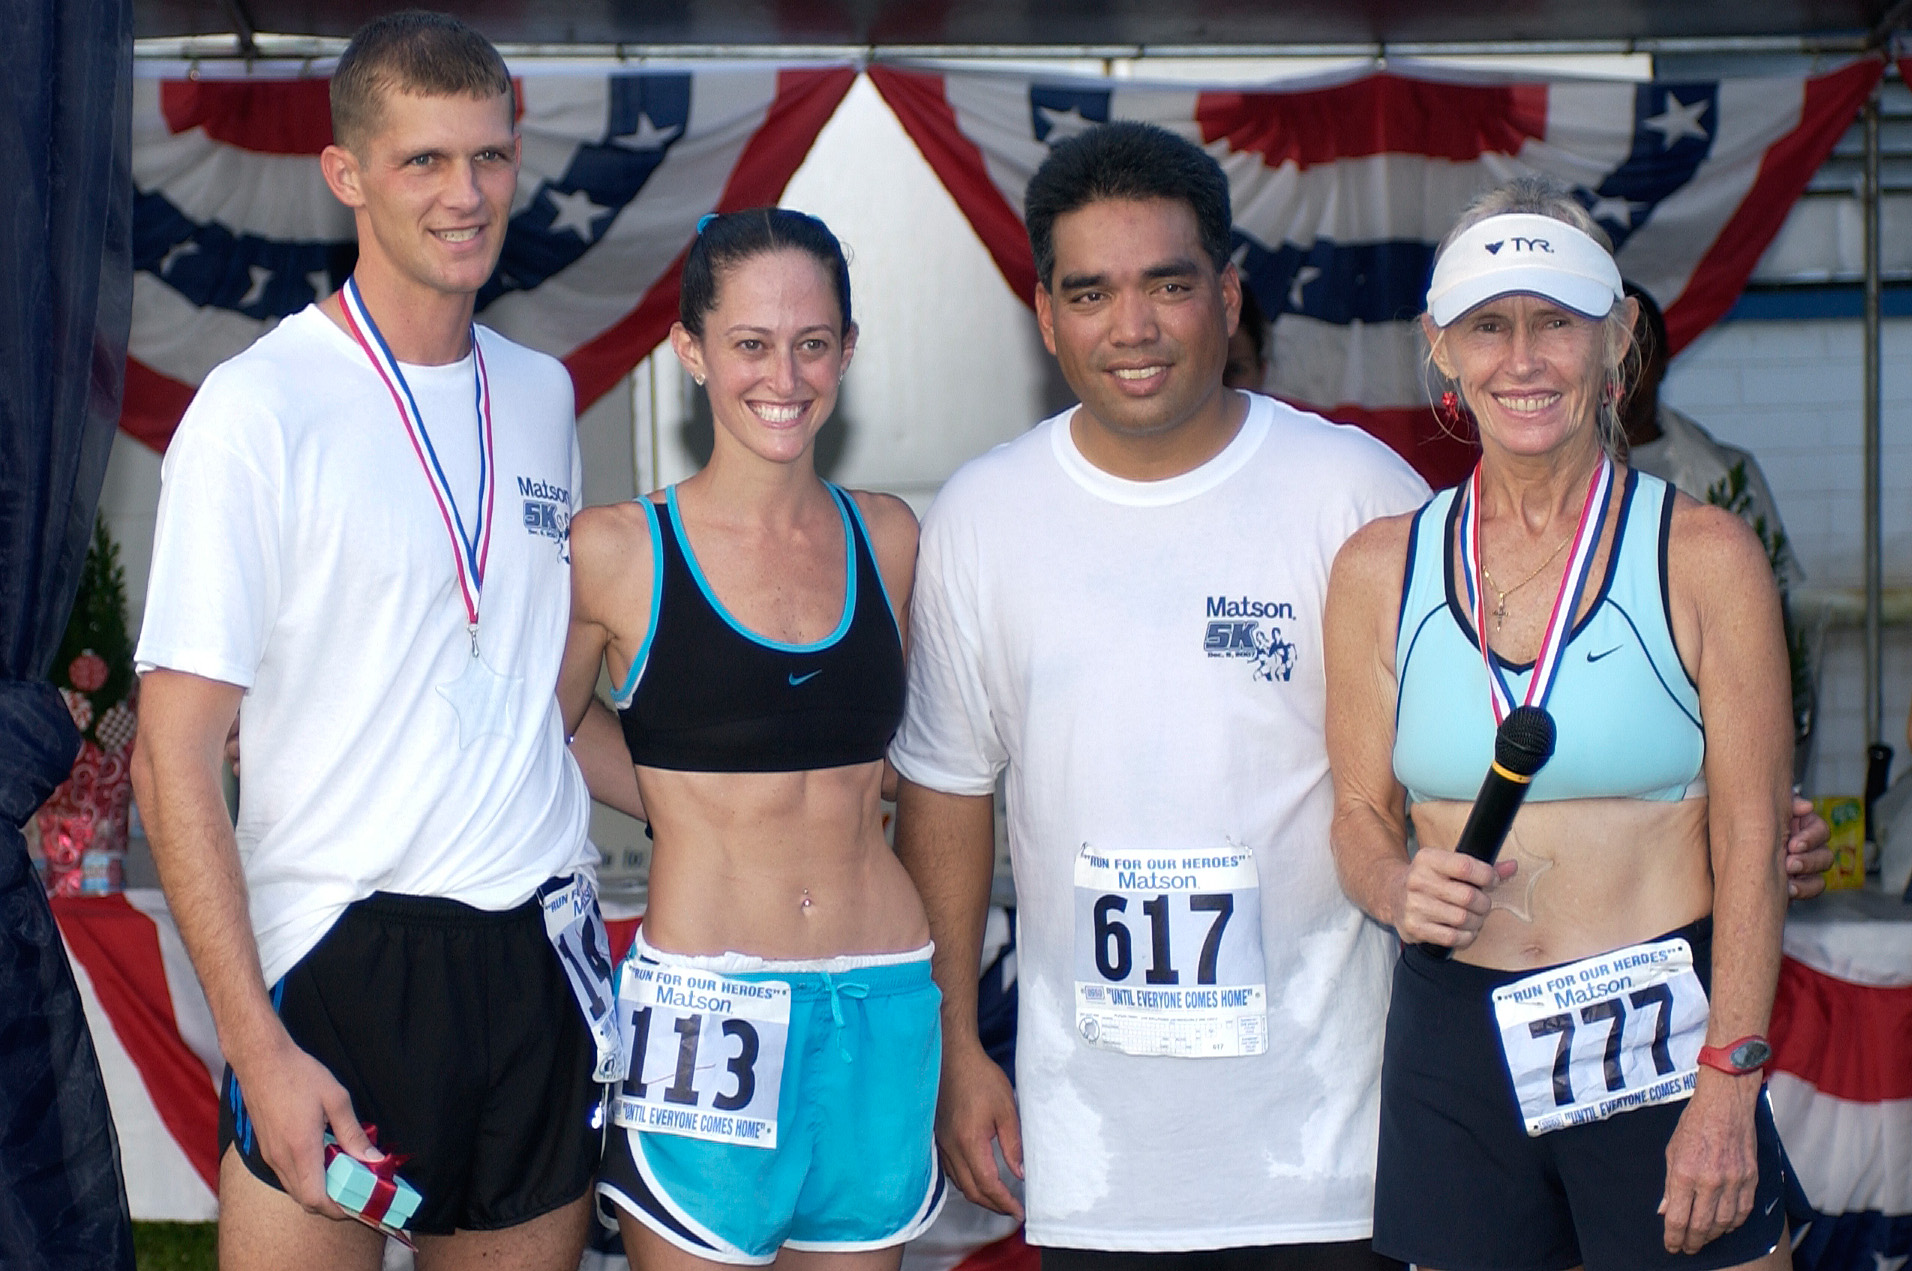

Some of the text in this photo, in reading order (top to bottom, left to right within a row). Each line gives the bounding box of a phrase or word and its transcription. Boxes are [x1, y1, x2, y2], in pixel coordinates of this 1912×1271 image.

[523, 500, 557, 530] 5K
[1204, 621, 1258, 651] 5K
[1114, 859, 1142, 870] FOR
[1147, 859, 1177, 870] OUR
[1093, 893, 1234, 986] 617
[656, 972, 682, 986] FOR
[687, 976, 716, 991] OUR
[1546, 974, 1575, 993] FOR
[1579, 963, 1611, 983] OUR
[1137, 990, 1182, 1010] EVERYONE
[1185, 990, 1218, 1009] COMES
[621, 1006, 760, 1112] 113
[1528, 982, 1676, 1107] 777
[1600, 1090, 1647, 1114] EVERYONE
[1649, 1078, 1682, 1101] COMES
[1682, 1071, 1698, 1091] HO
[649, 1107, 698, 1130] EVERYONE
[700, 1114, 733, 1136] COMES
